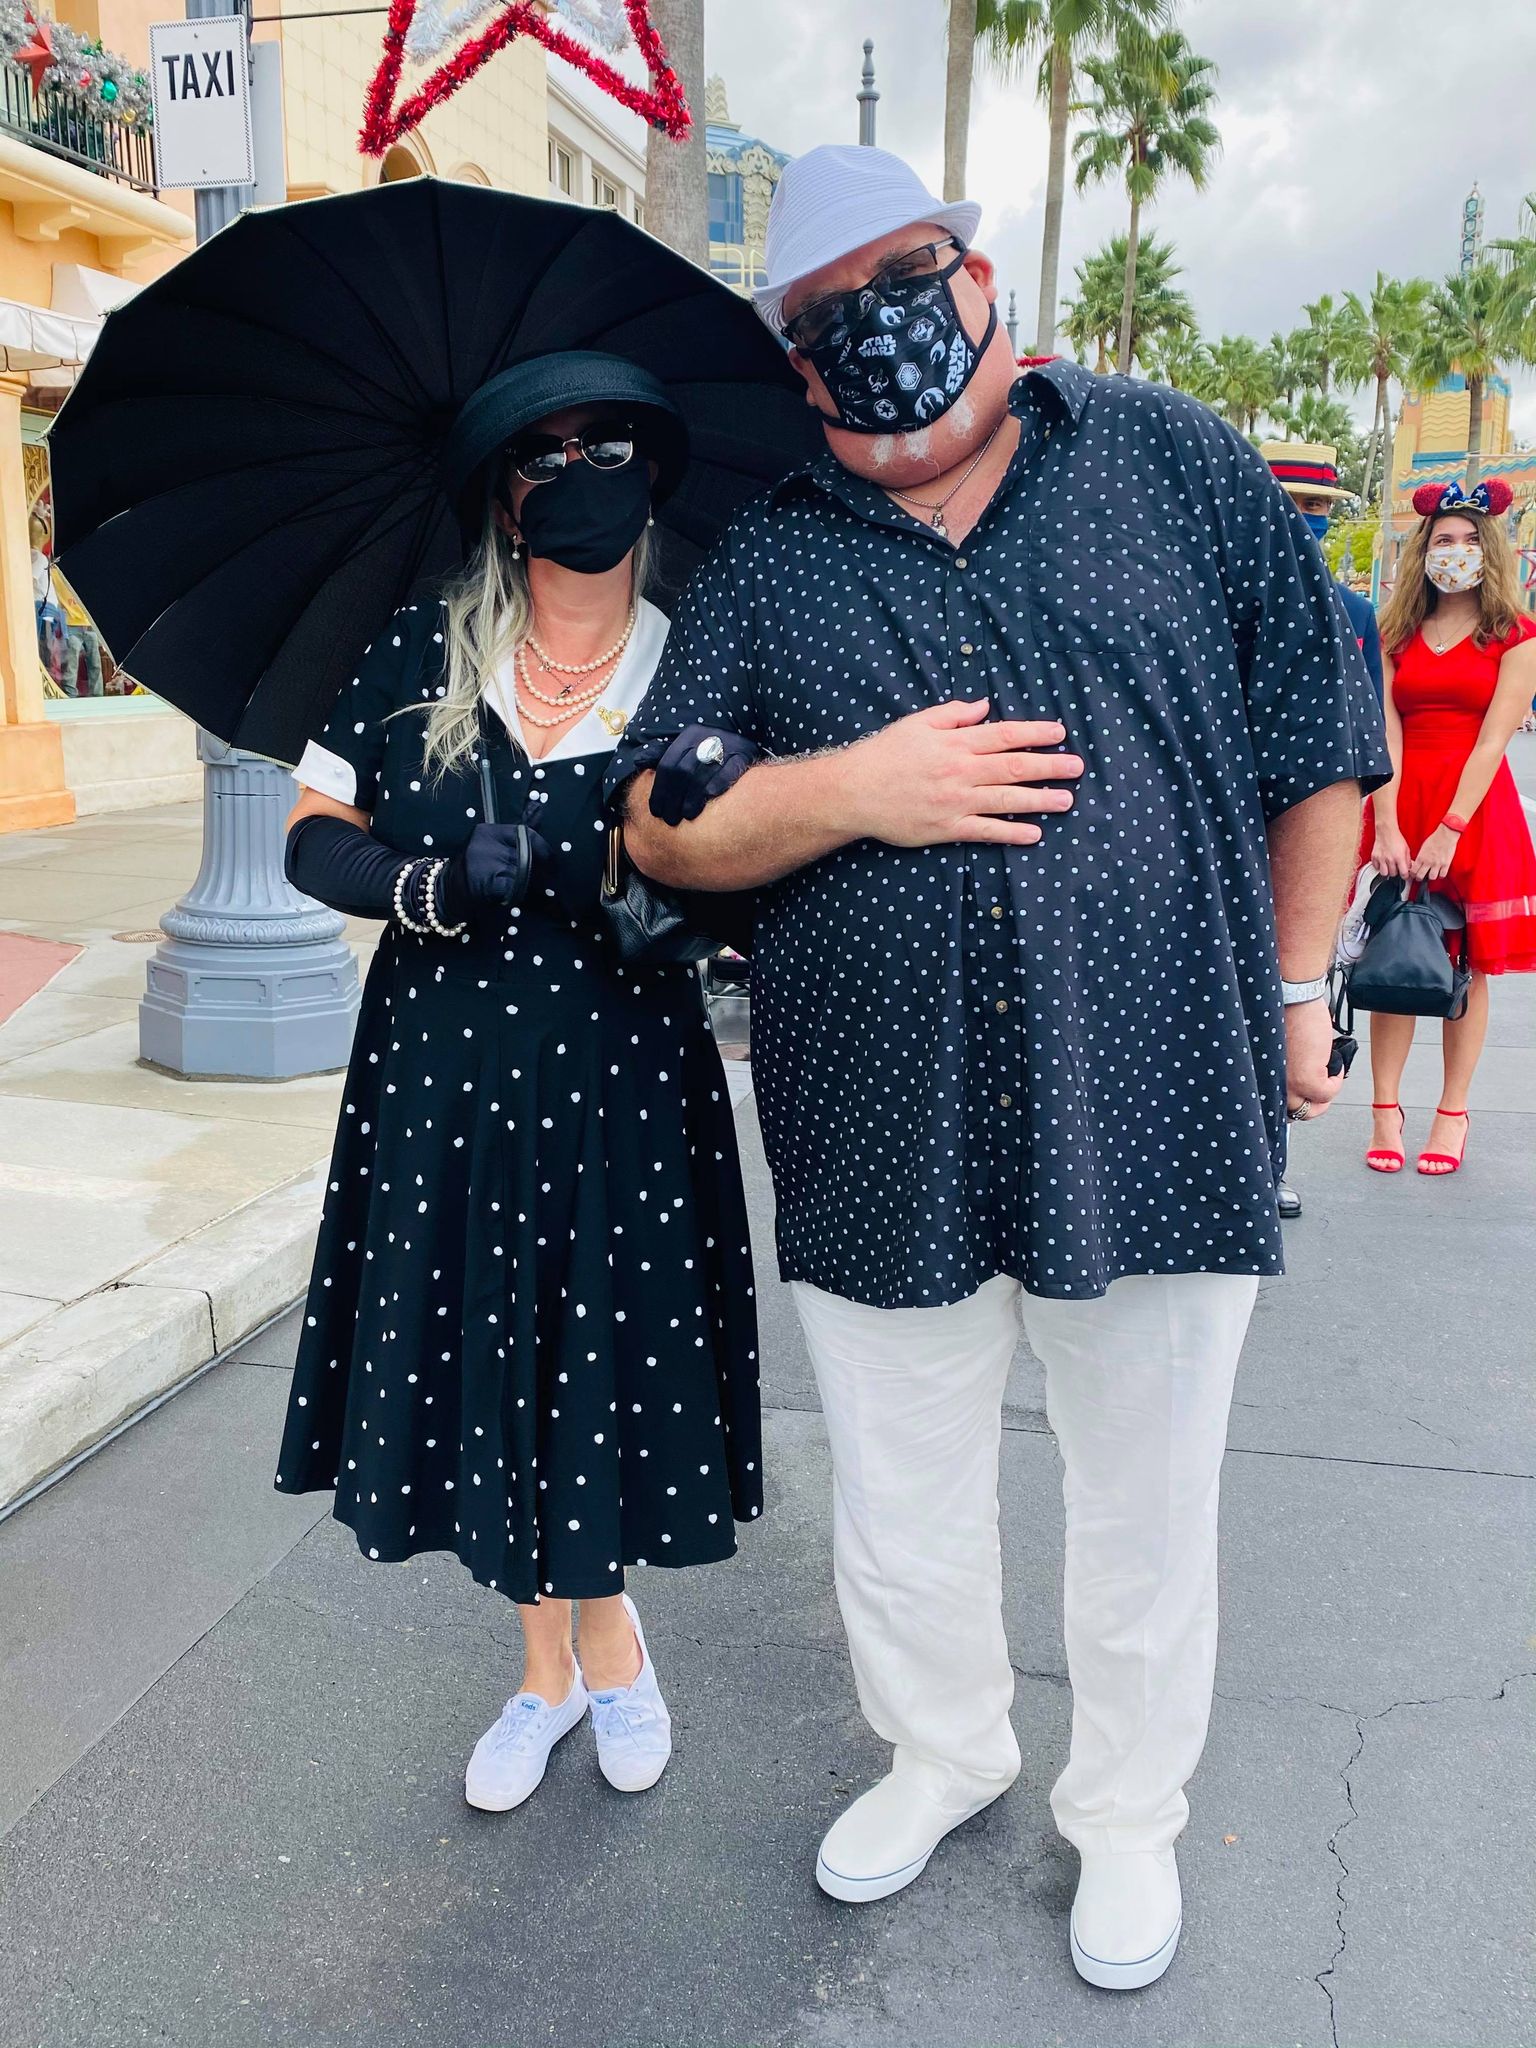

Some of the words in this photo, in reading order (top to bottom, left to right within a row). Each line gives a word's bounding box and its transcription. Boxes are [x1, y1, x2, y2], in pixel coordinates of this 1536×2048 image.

[161, 50, 235, 100] TAXI
[858, 334, 896, 350] STAR
[858, 343, 897, 357] WARS
